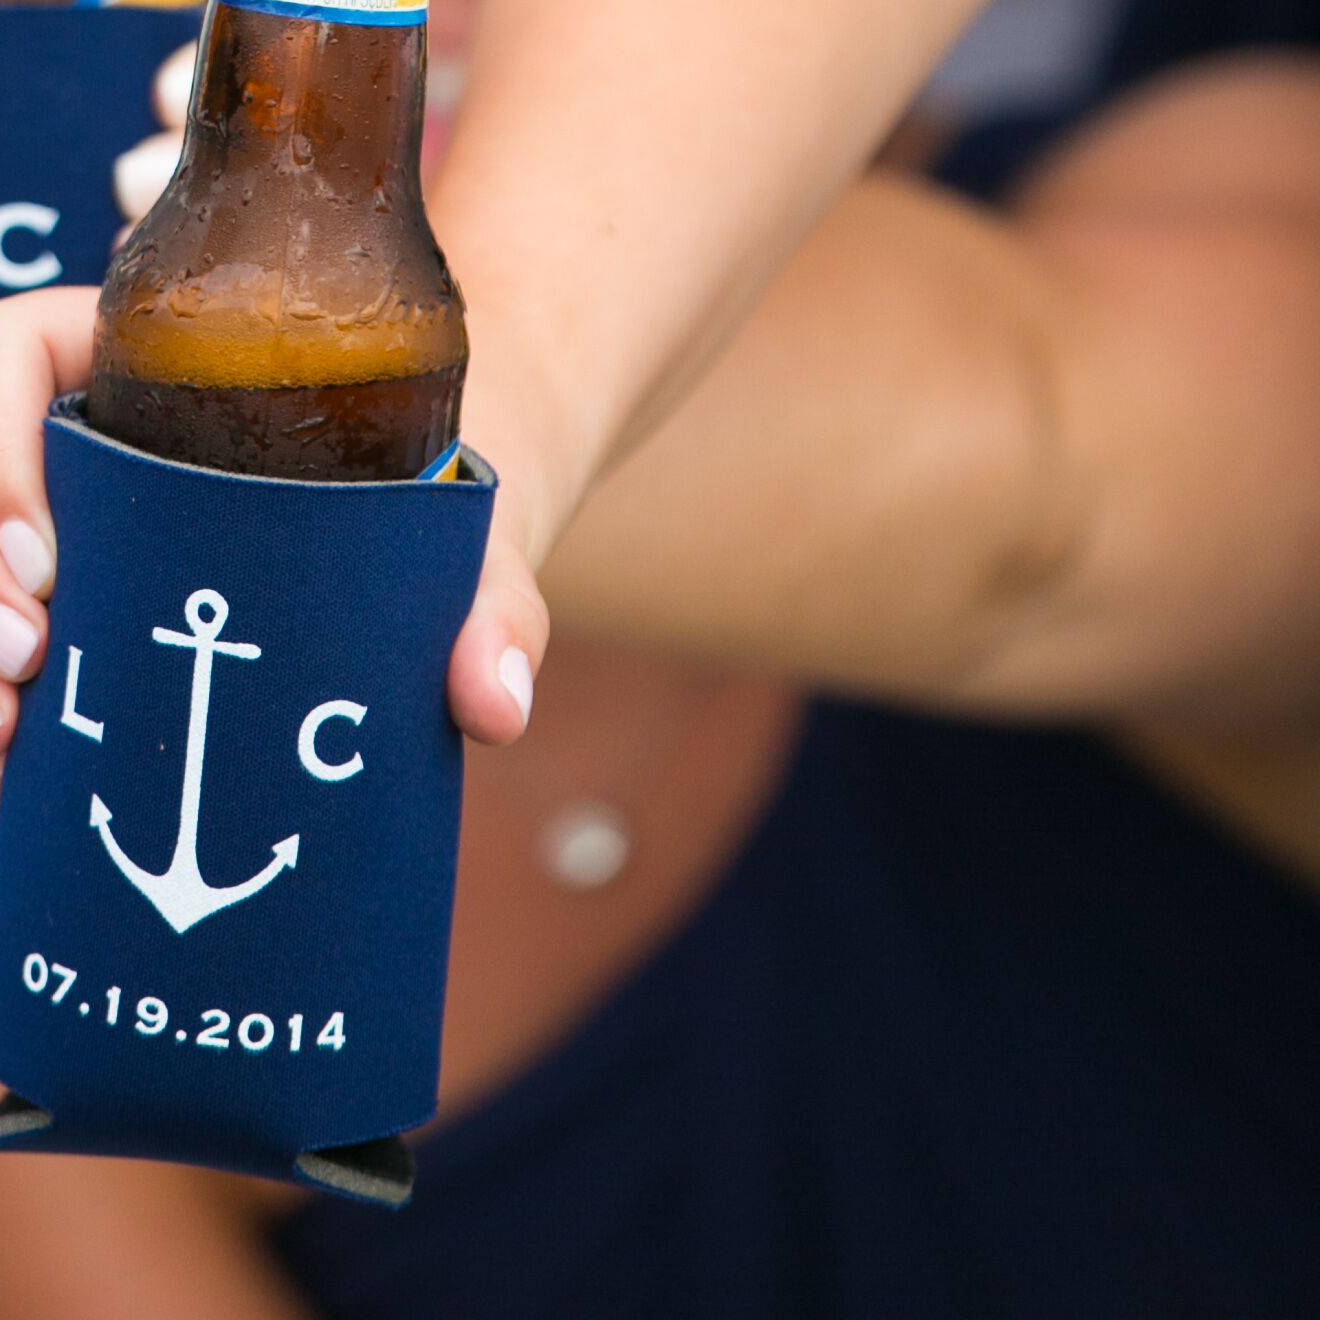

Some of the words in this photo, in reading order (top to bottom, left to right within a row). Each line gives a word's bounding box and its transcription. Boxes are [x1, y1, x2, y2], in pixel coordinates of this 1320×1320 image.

[60, 645, 104, 743] L
[297, 699, 368, 782] C
[22, 952, 346, 1052] 07.19.2014
